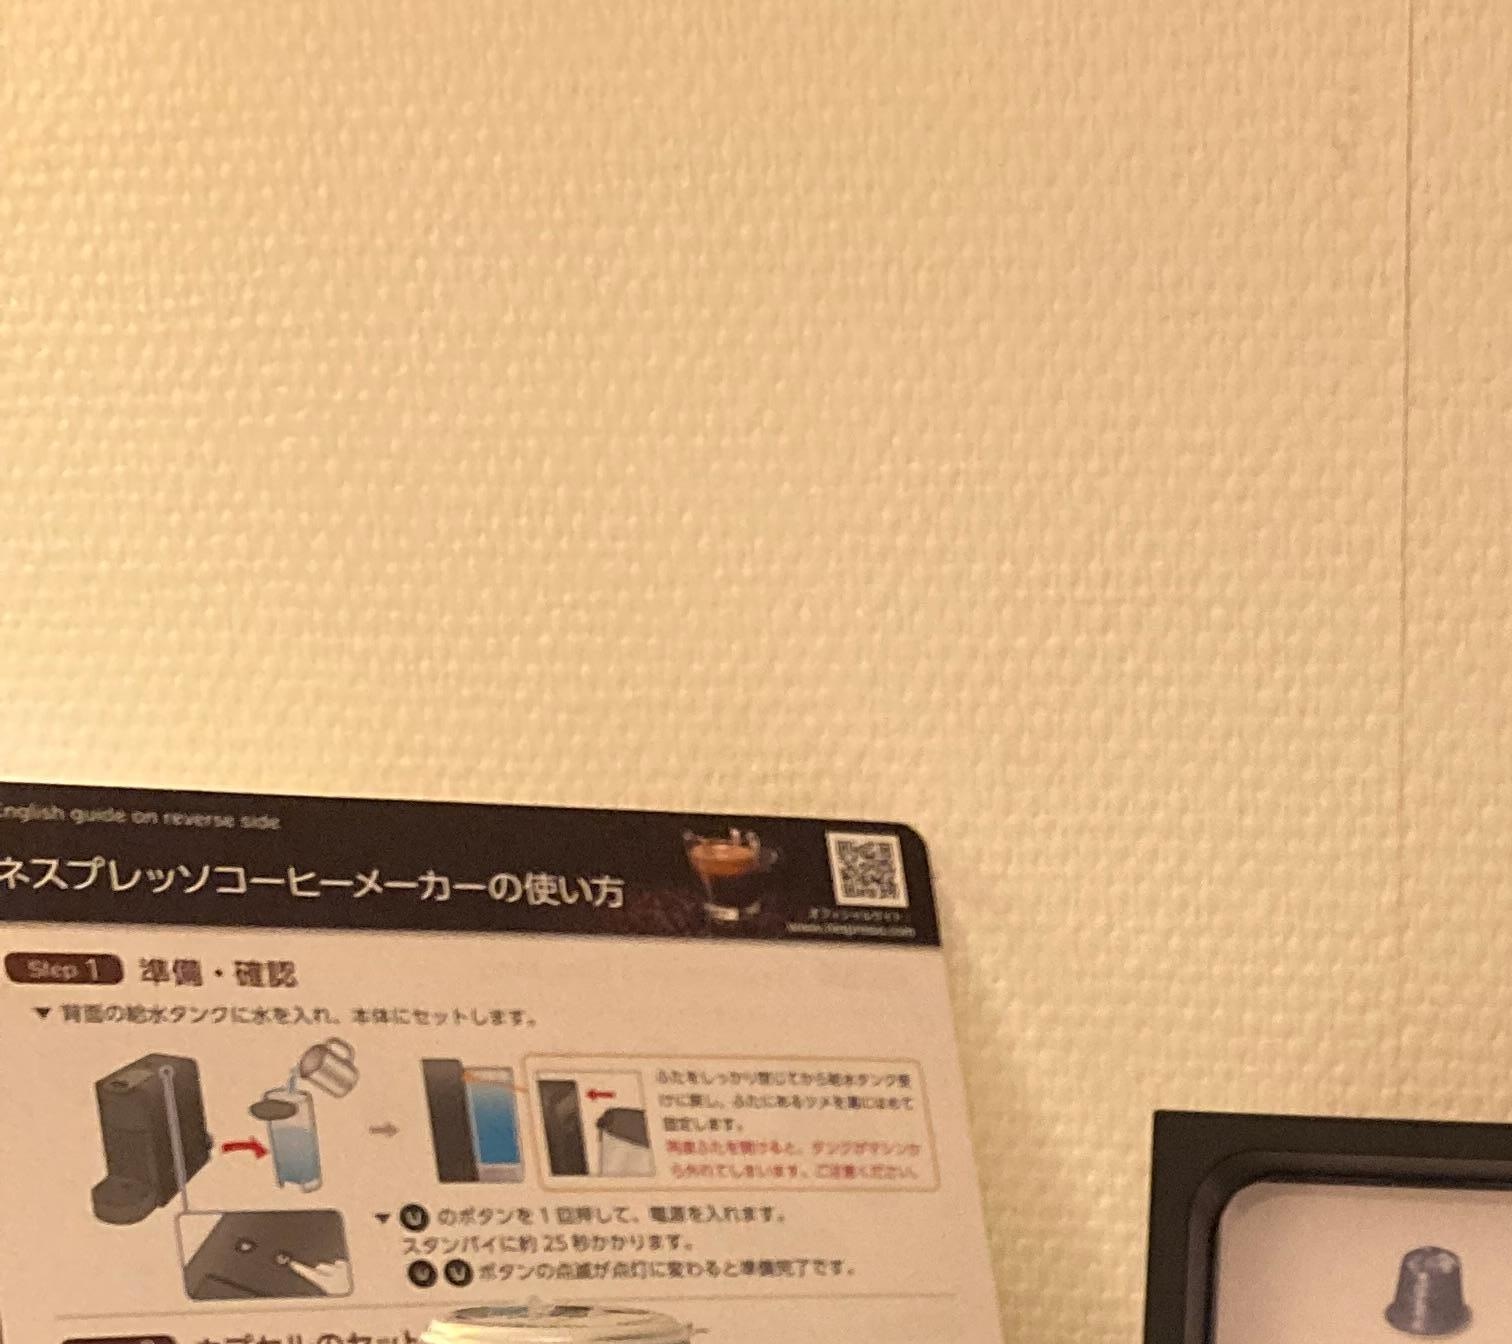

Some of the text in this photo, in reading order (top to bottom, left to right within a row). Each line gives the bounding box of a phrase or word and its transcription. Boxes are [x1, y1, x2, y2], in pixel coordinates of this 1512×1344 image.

[0, 802, 281, 831] nglish guide on reverse side
[0, 856, 626, 909] ネスプレッソコーヒーメーカーの使い方
[84, 956, 99, 981] 1
